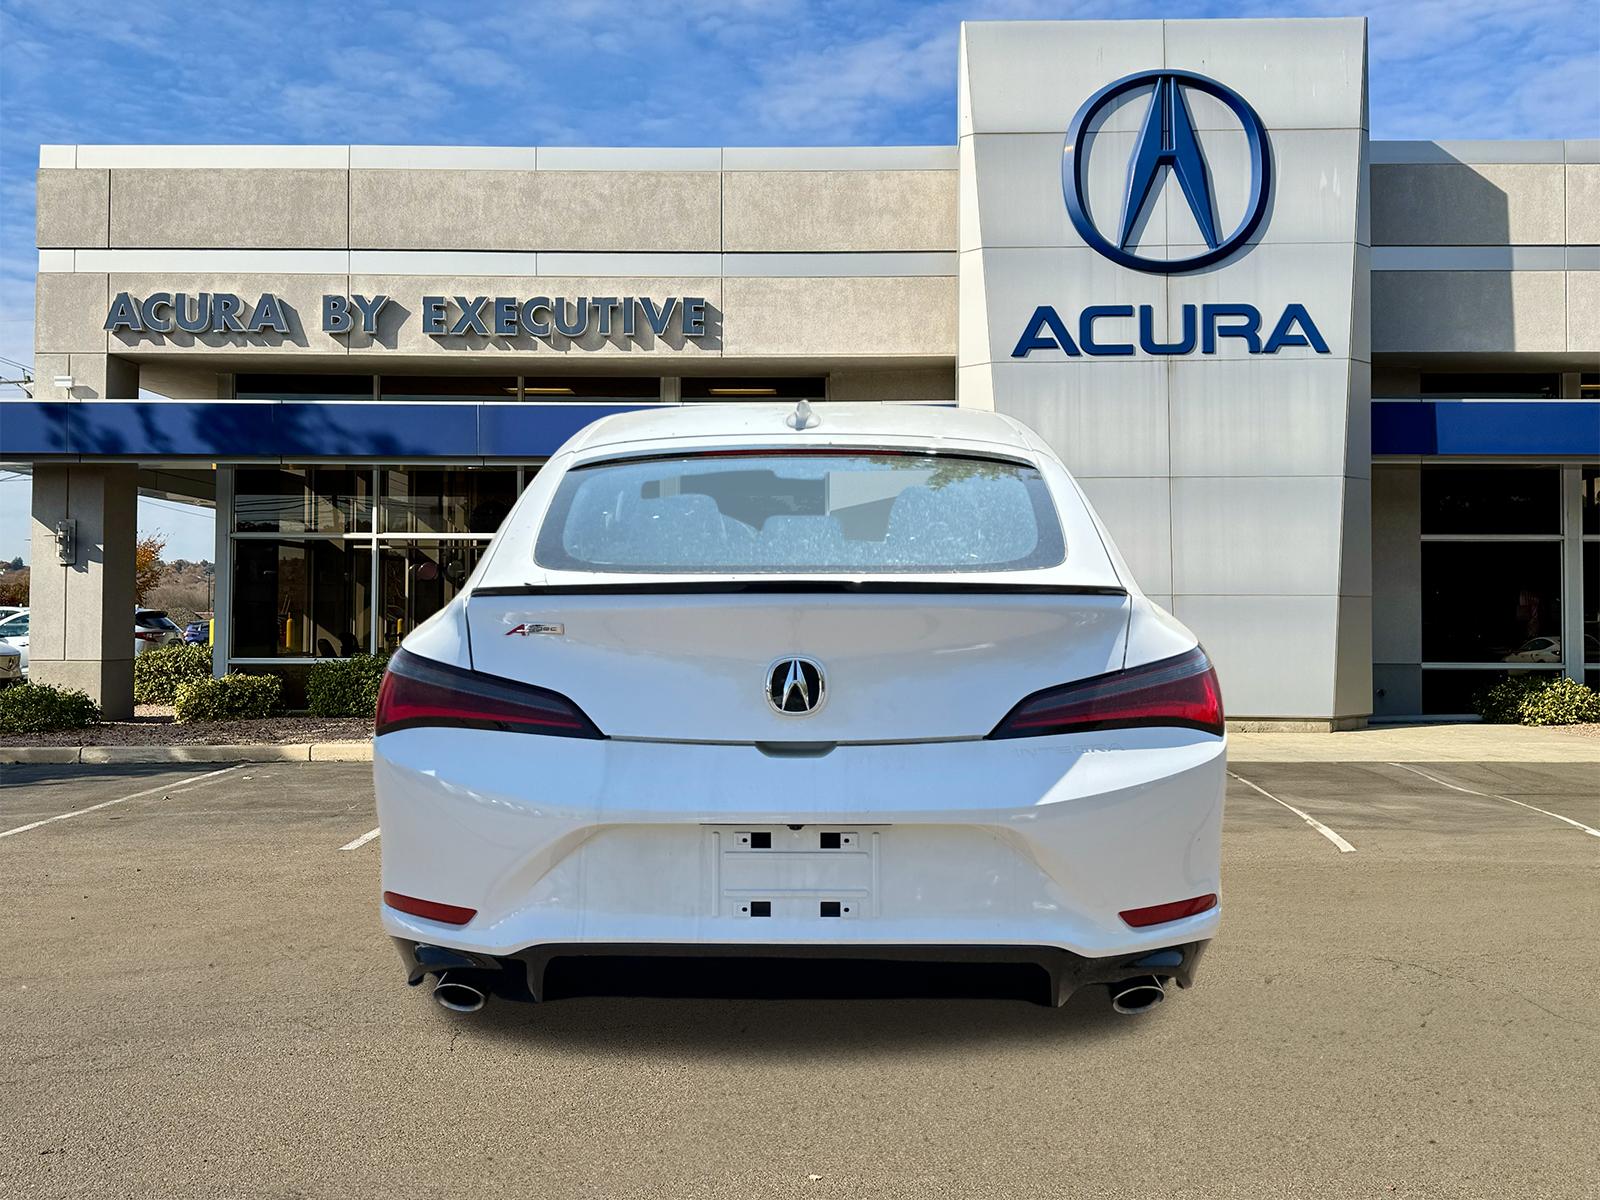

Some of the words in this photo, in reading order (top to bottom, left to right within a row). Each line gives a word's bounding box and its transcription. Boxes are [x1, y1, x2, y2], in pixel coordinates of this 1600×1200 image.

[103, 292, 290, 333] ACURA
[322, 295, 389, 334] BY
[422, 296, 706, 336] EXECUTIVE
[1011, 303, 1331, 357] ACURA
